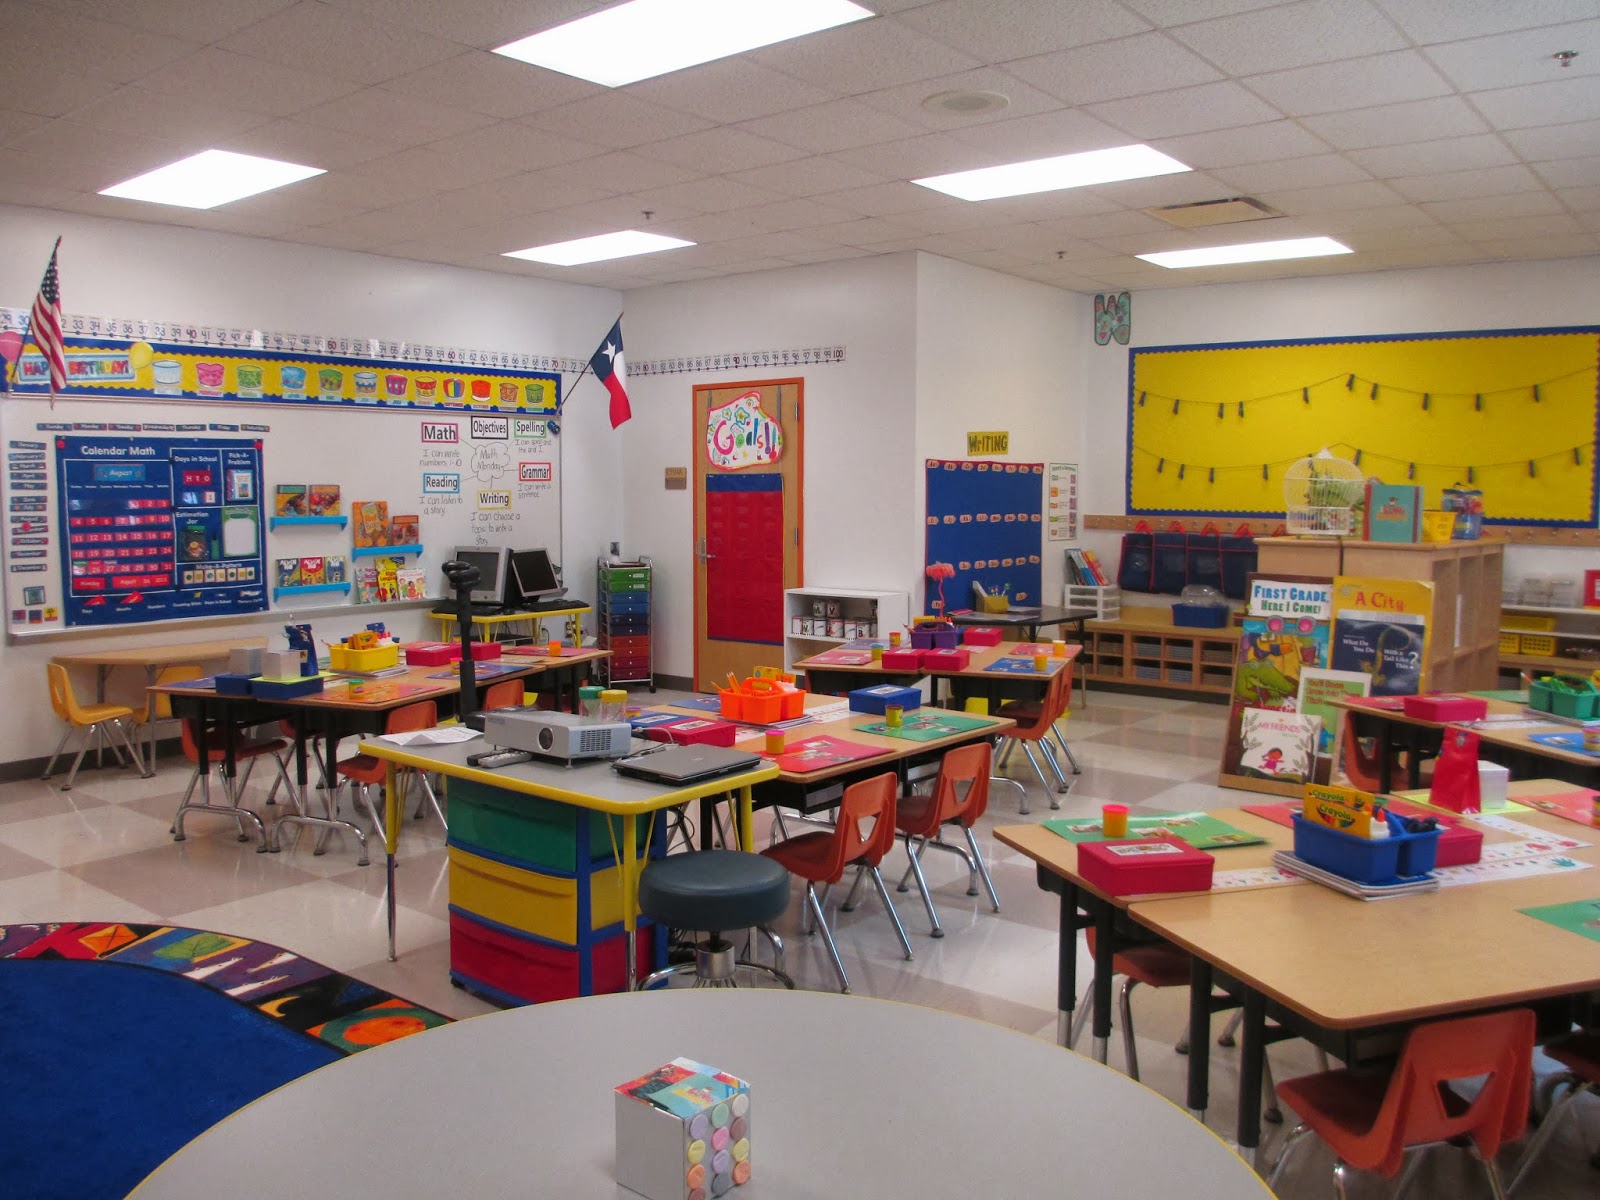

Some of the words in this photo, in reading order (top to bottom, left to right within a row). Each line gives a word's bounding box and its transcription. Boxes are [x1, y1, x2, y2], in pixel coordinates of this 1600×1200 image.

[73, 320, 83, 330] 33
[90, 321, 100, 331] 34
[107, 323, 117, 332] 35
[123, 324, 133, 333] 36
[139, 325, 148, 335] 37
[187, 329, 197, 339] 40
[202, 331, 210, 340] 41
[824, 350, 831, 358] 99
[833, 350, 843, 358] 100
[552, 360, 558, 368] 70
[733, 356, 740, 364] 90
[424, 425, 456, 440] Math
[473, 420, 506, 436] Objectives
[516, 420, 545, 435] Spelling
[81, 446, 127, 456] Calendar
[129, 447, 156, 456] Math
[422, 449, 430, 457] I
[432, 450, 443, 458] can
[480, 448, 498, 459] Math
[521, 464, 549, 479] Grammar
[426, 476, 458, 491] Reading
[479, 492, 510, 506] Writing
[470, 511, 478, 521] I
[479, 512, 491, 521] can
[1254, 585, 1287, 600] FIRST
[1261, 599, 1284, 612] HERE
[1286, 602, 1290, 612] I
[1293, 603, 1322, 614] COME!
[1355, 591, 1366, 605] A
[1371, 592, 1405, 612] City
[1271, 723, 1300, 732] FRIENDS
[1312, 790, 1345, 801] Crayola
[1319, 803, 1352, 819] Crayola
